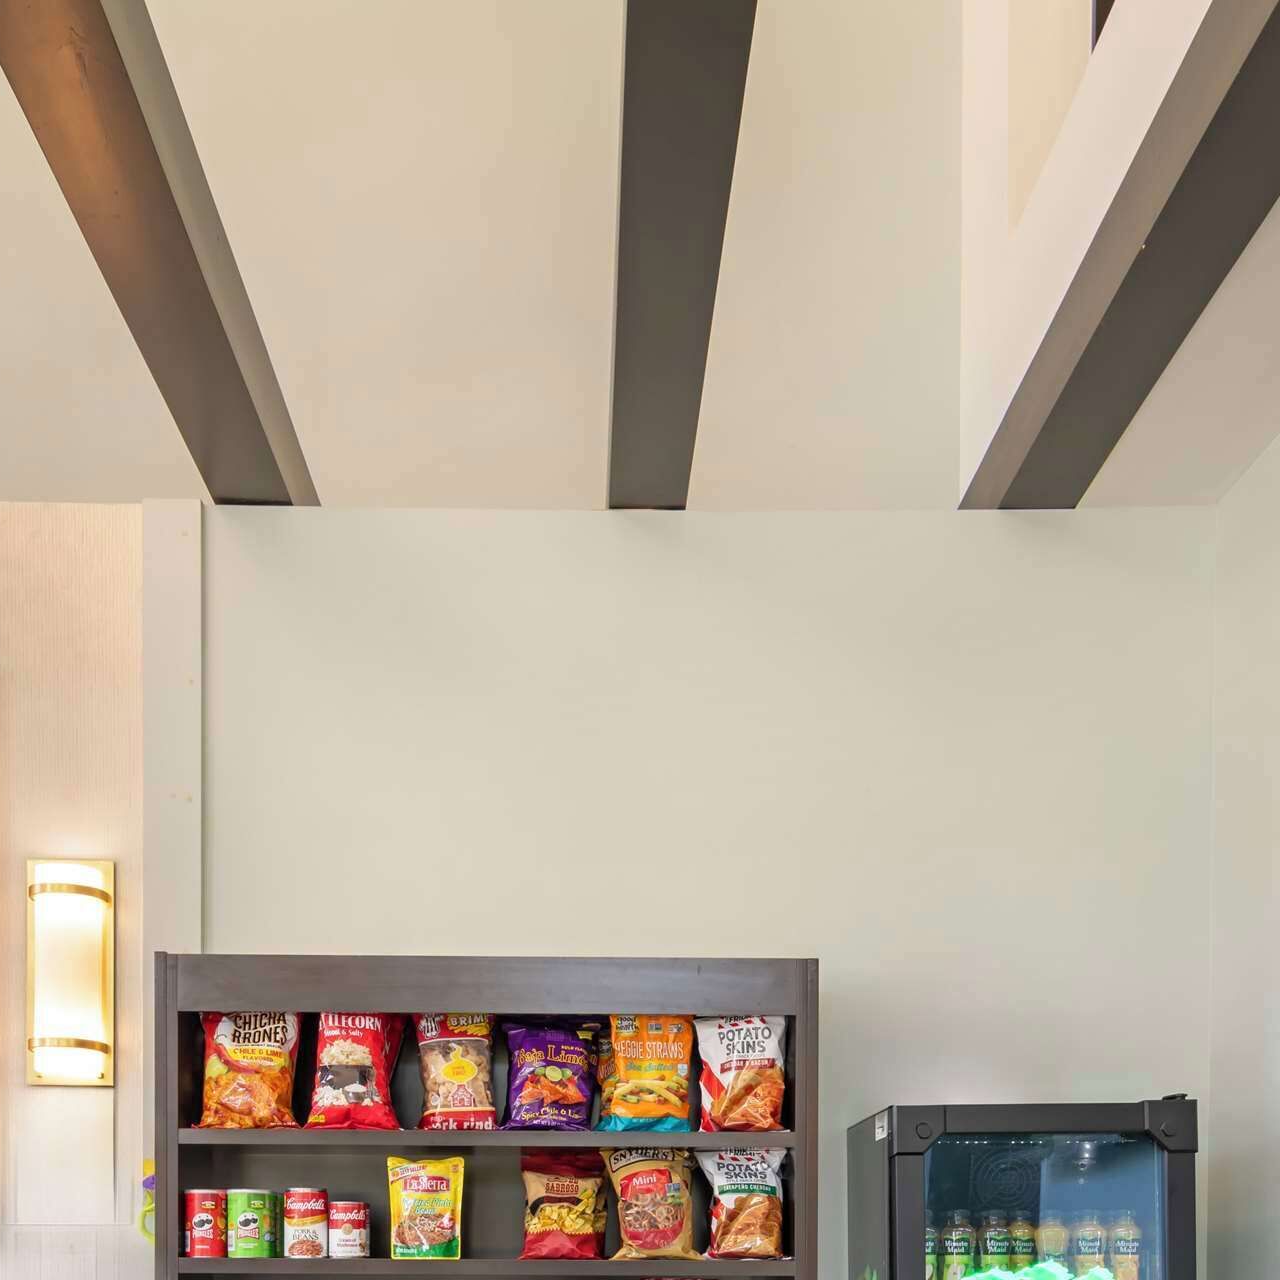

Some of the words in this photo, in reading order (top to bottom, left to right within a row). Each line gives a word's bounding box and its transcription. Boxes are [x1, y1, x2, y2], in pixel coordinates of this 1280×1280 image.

[234, 1012, 287, 1030] CHICHA
[232, 1025, 288, 1046] RRONES
[718, 1027, 772, 1044] POTATO
[646, 1042, 684, 1059] STRAWS
[726, 1040, 766, 1056] SKINS
[717, 1161, 769, 1171] POTATO
[545, 1183, 579, 1193] SABROSO
[632, 1174, 657, 1186] Mini
